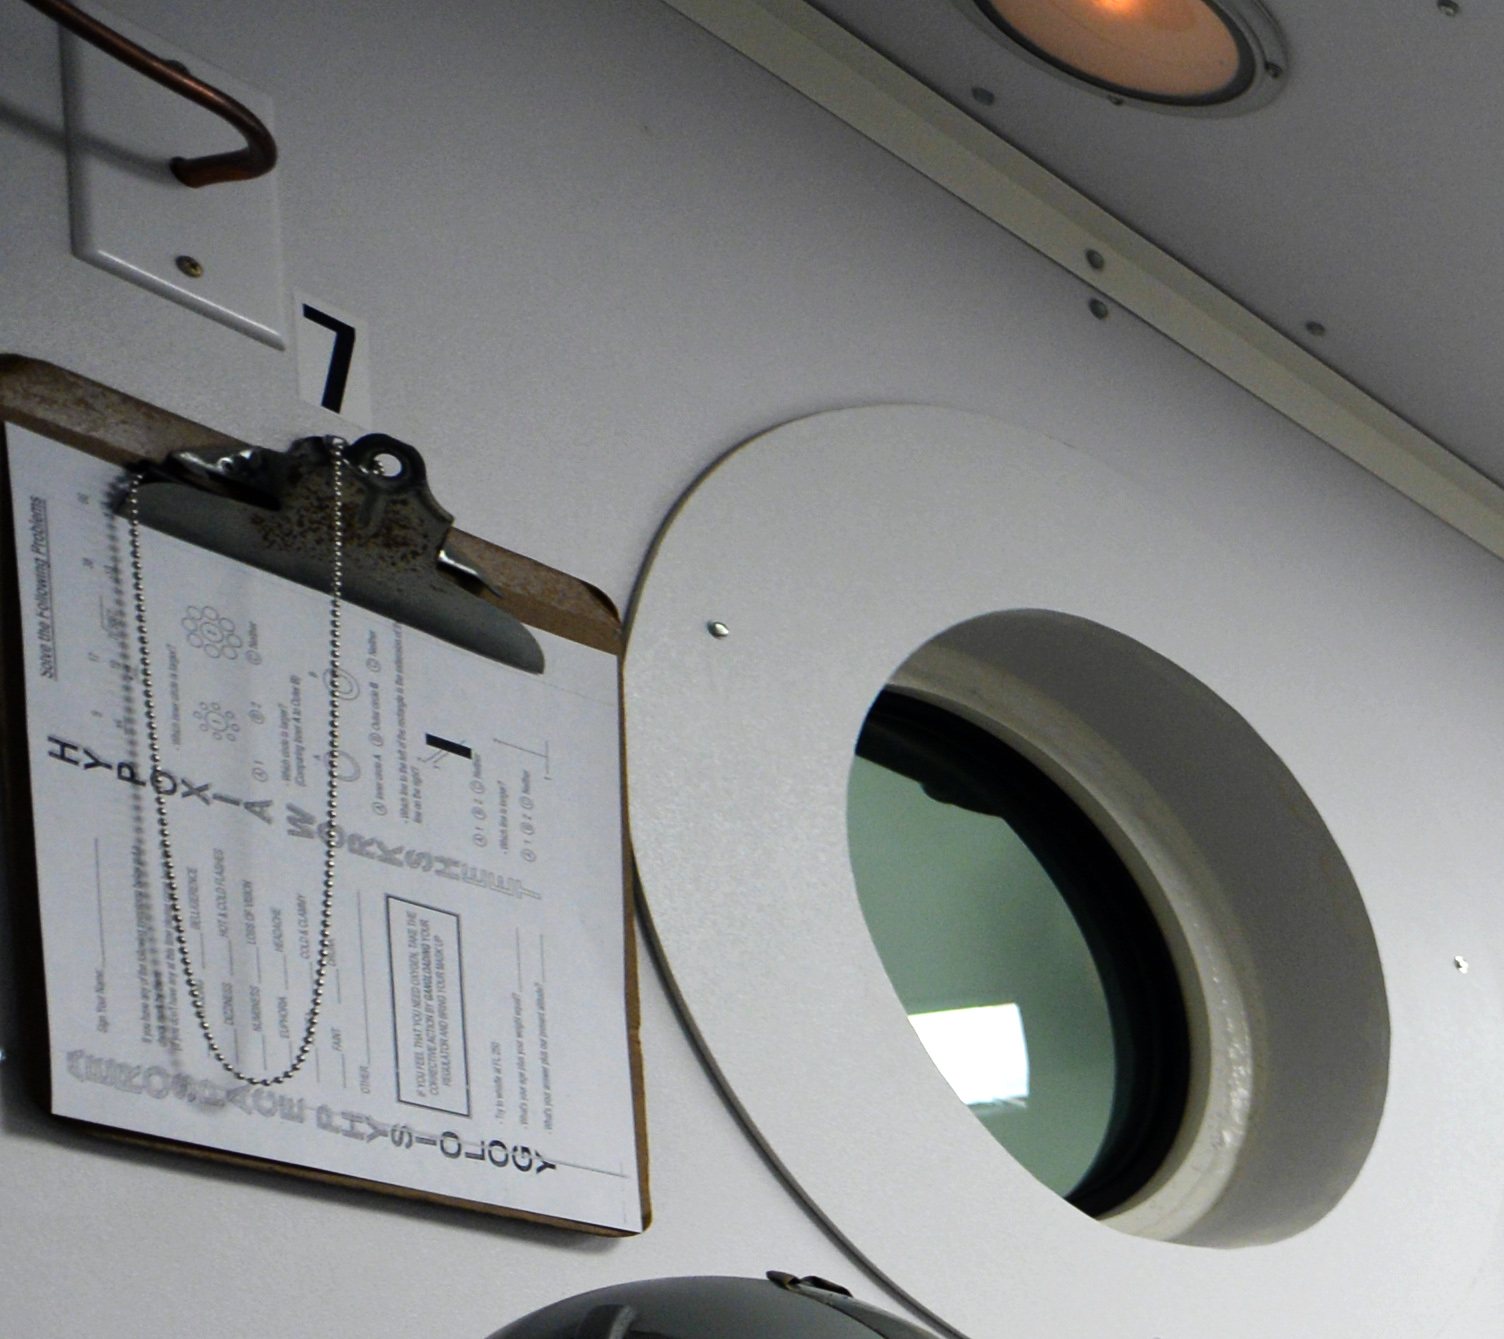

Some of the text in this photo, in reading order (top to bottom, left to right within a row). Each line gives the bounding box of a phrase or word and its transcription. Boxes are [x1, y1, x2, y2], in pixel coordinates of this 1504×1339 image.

[301, 301, 357, 412] 7
[29, 496, 52, 678] Solve the Following Problems
[47, 736, 540, 899] HYPOXIA WORKSHEET
[213, 848, 225, 886] FLASHES
[215, 887, 228, 911] COLD
[243, 880, 256, 945] LOSS OF VISION
[297, 894, 309, 929] CLAMMY
[407, 910, 417, 926] THE
[218, 918, 229, 938] HOT
[272, 907, 284, 953] HEADACHE
[408, 928, 418, 949] TAKE
[420, 919, 431, 942] YOUR
[299, 937, 311, 959] COLD
[96, 995, 106, 1013] Your
[411, 987, 421, 1008] NEED
[424, 1002, 435, 1014] BY
[250, 985, 262, 1032] NUMBNESS
[278, 996, 291, 1039] EUPHORIA
[412, 1009, 422, 1026] YOU
[434, 935, 452, 1087] REGULATOR AND BRING YOUR MASK UP
[96, 1020, 109, 1033] Sign
[425, 1015, 436, 1044] ACTION
[513, 1017, 525, 1038] weight
[331, 1028, 342, 1051] FAINT
[413, 1027, 423, 1048] THAT
[515, 1040, 526, 1054] your
[538, 1039, 548, 1049] our
[414, 1051, 424, 1070] FEEL
[492, 1056, 501, 1066] FL
[515, 1056, 526, 1071] plus
[539, 1051, 550, 1065] plus
[360, 1066, 371, 1094] OTHER
[415, 1071, 425, 1087] YOU
[427, 1044, 439, 1096] CORRECTIVE
[492, 1067, 502, 1075] at
[516, 1072, 528, 1085] age
[540, 1067, 551, 1090] answer
[416, 1089, 426, 1098] IF
[494, 1099, 504, 1107] to
[517, 1086, 529, 1100] your
[541, 1091, 553, 1106] your
[495, 1108, 506, 1119] Try
[517, 1102, 529, 1125] What's
[541, 1108, 553, 1130] What's
[317, 1105, 556, 1174] PHYSIOLOGY
